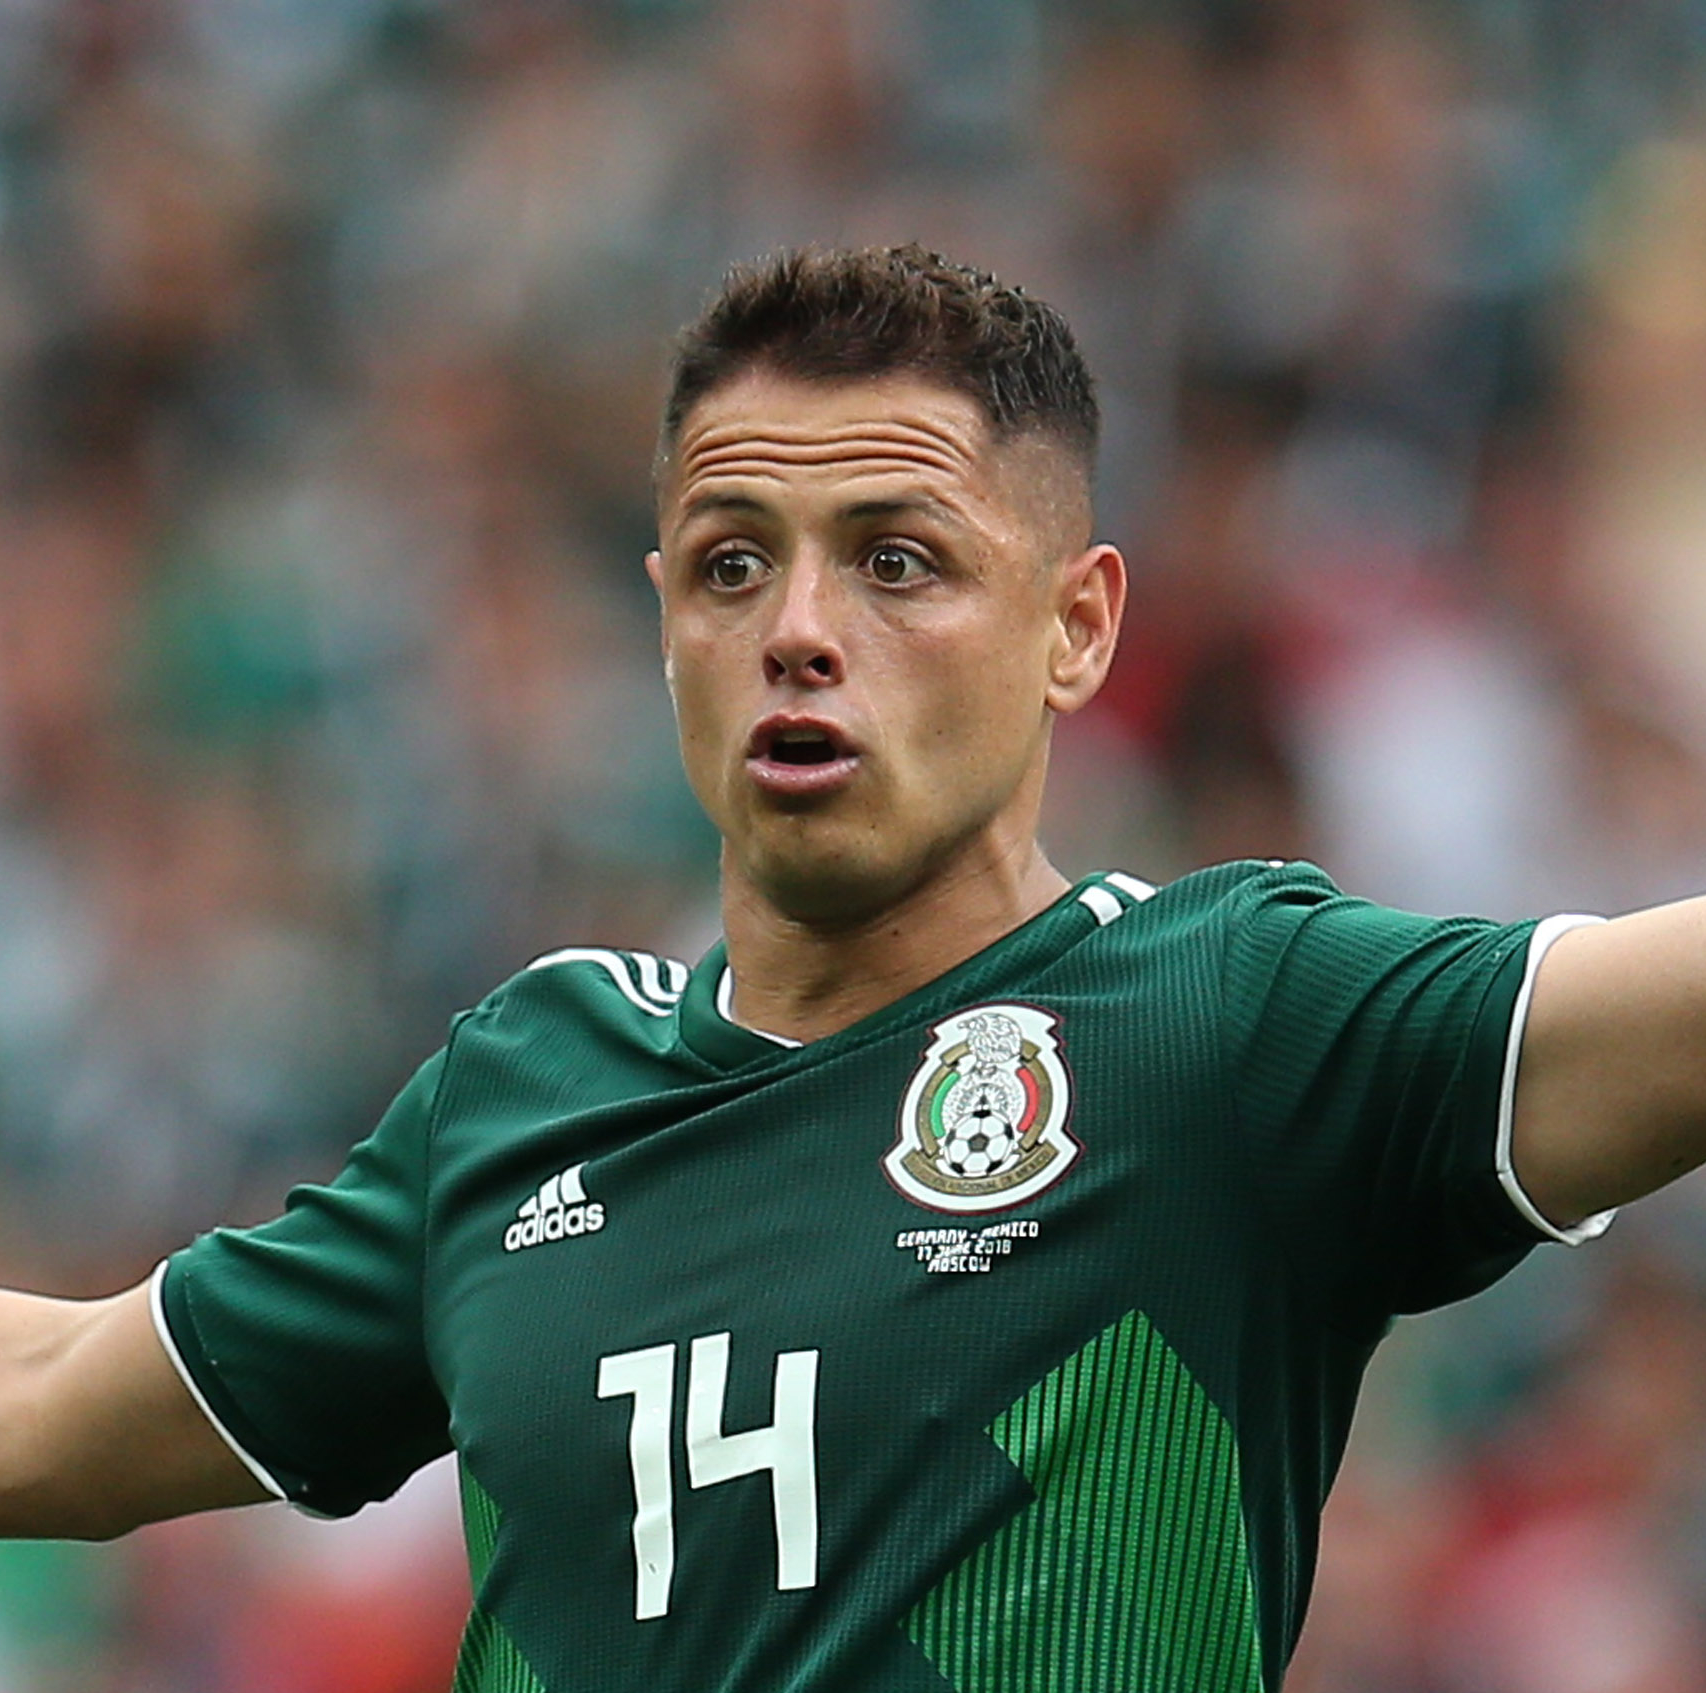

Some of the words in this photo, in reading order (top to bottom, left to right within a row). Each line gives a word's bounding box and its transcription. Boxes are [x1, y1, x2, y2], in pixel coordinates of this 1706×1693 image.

[504, 1202, 606, 1252] adidas
[896, 1229, 968, 1248] GERMANY
[980, 1221, 1039, 1238] MEXICO
[917, 1246, 932, 1261] 17
[974, 1238, 1012, 1254] 2018
[927, 1255, 991, 1272] MOSCOW
[597, 1331, 819, 1621] 14
